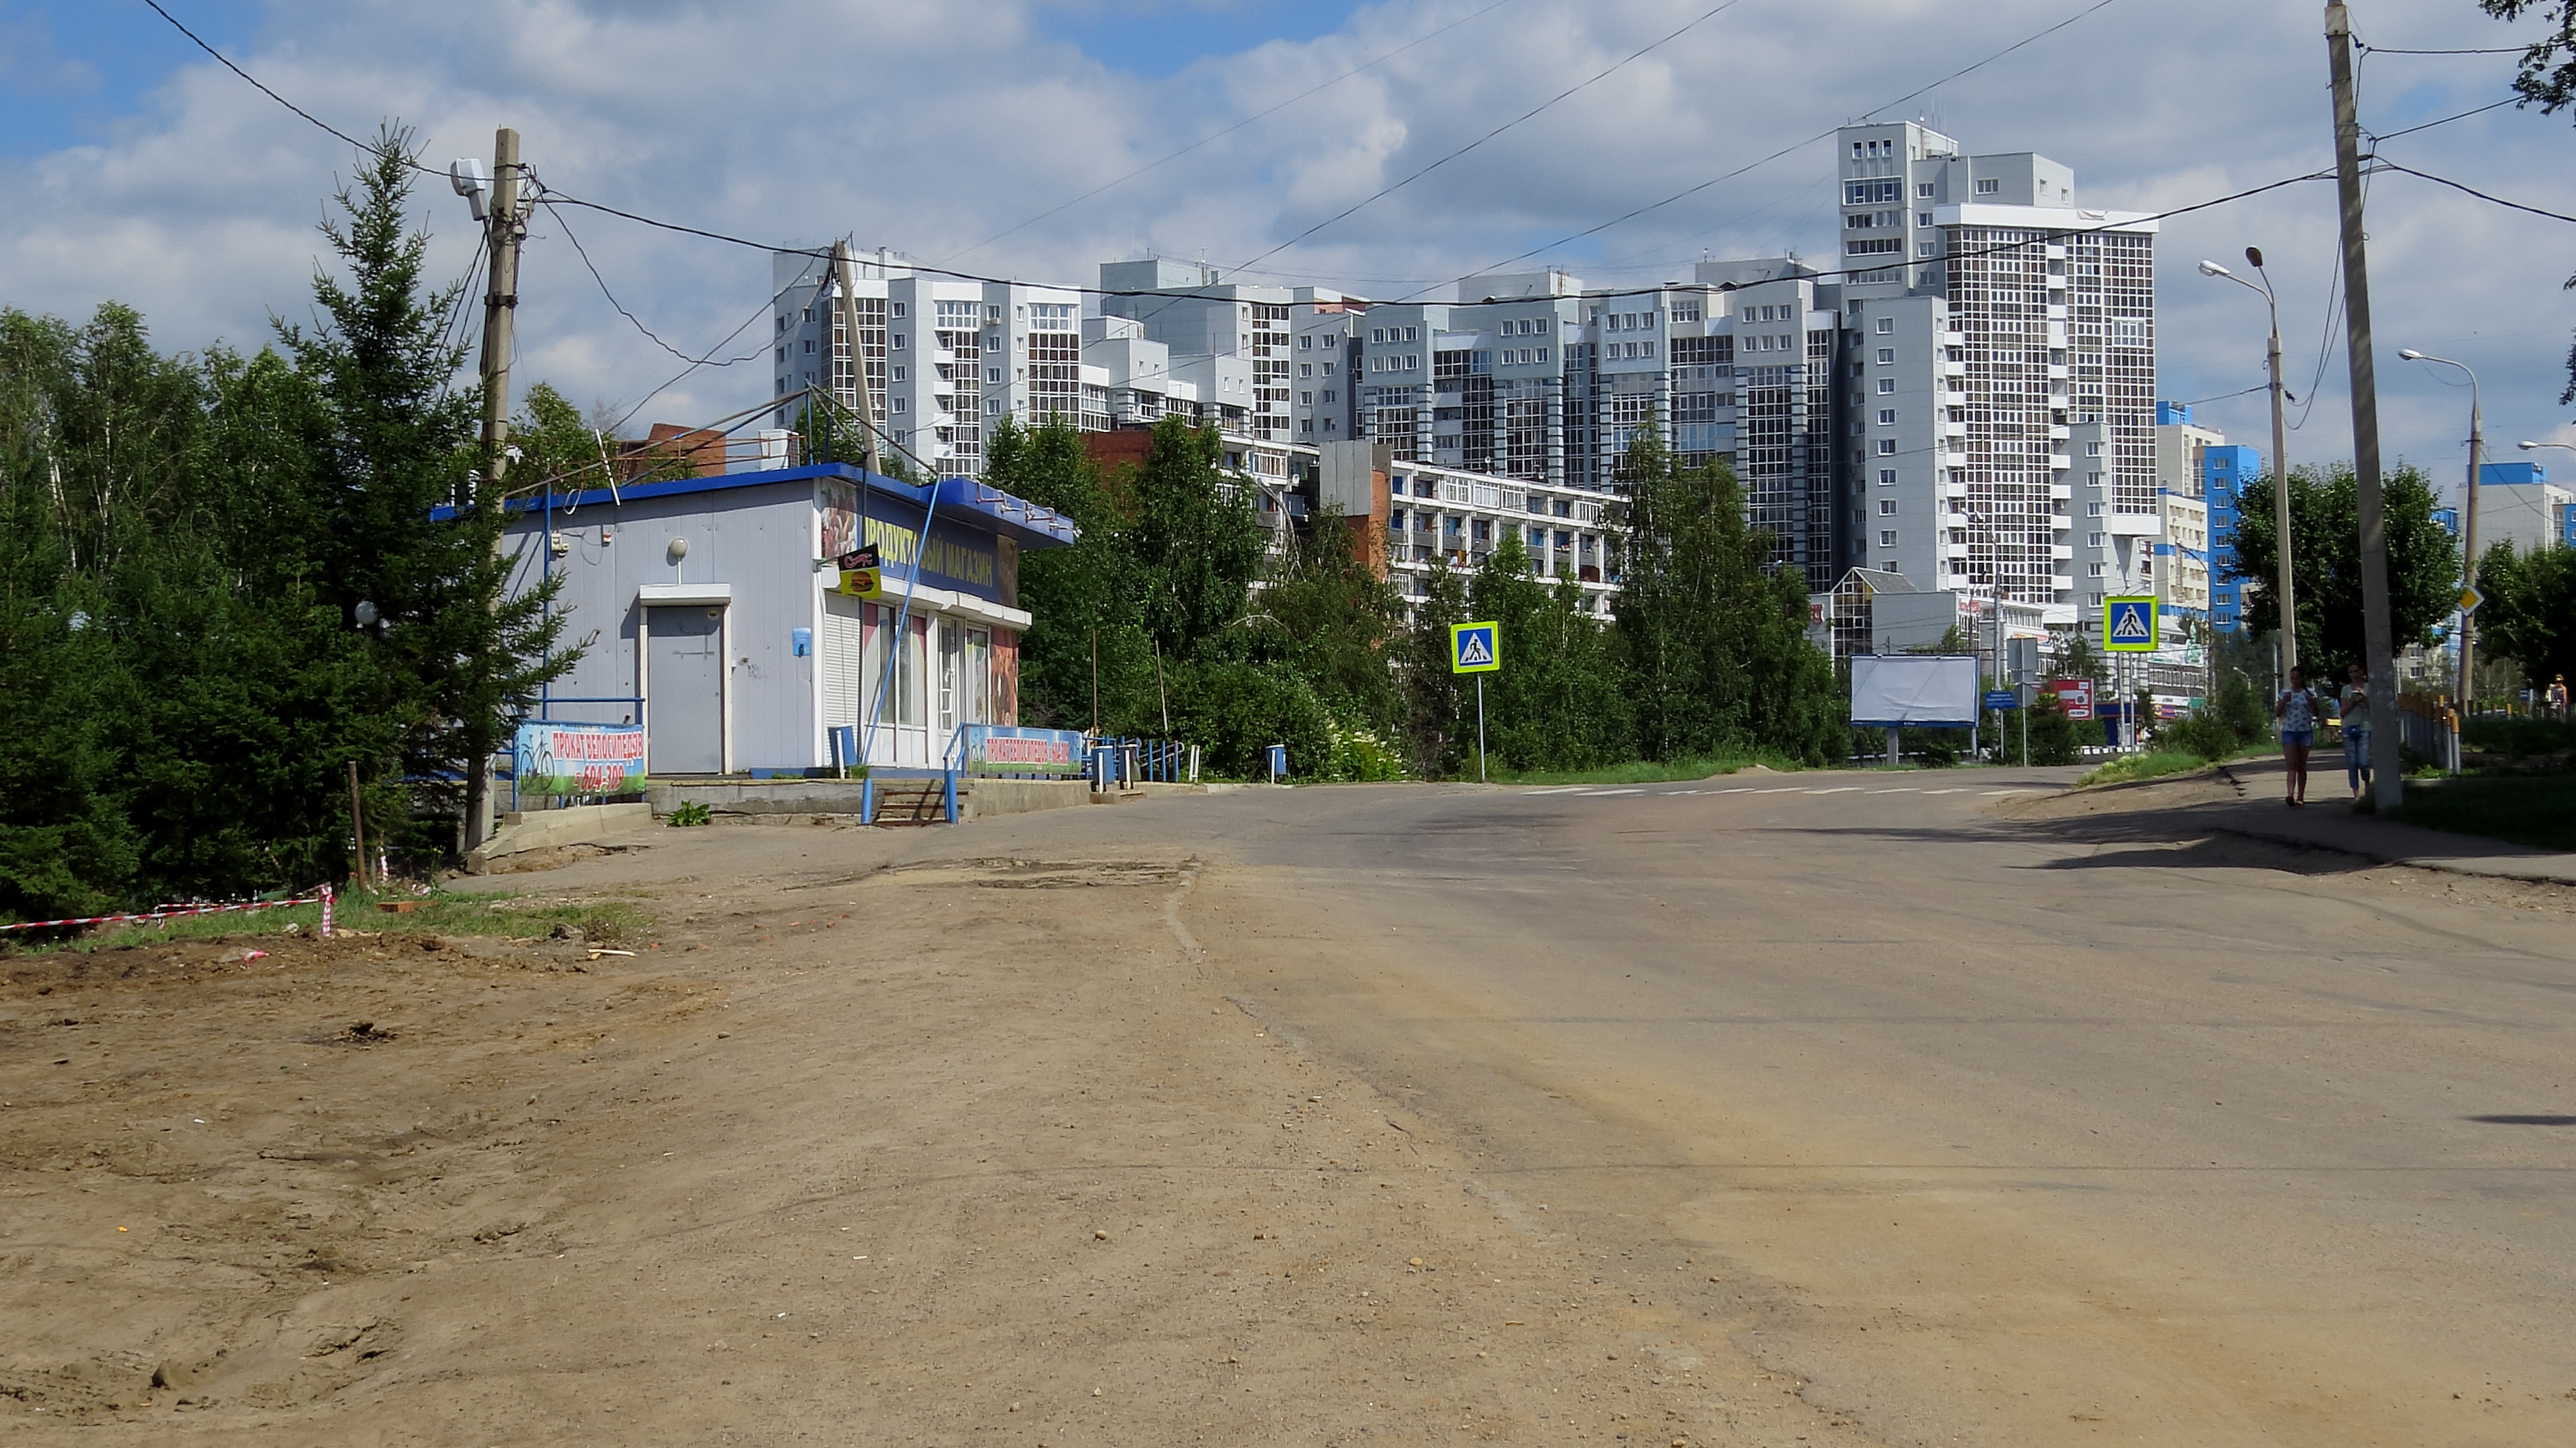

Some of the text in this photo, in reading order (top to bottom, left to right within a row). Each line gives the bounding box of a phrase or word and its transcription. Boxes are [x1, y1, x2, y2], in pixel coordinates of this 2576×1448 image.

[946, 542, 992, 587] МАГАЗИН
[553, 732, 643, 759] ПРОКАТ ВЕЛОСИПЕДОВ
[581, 764, 624, 791] 604-309
